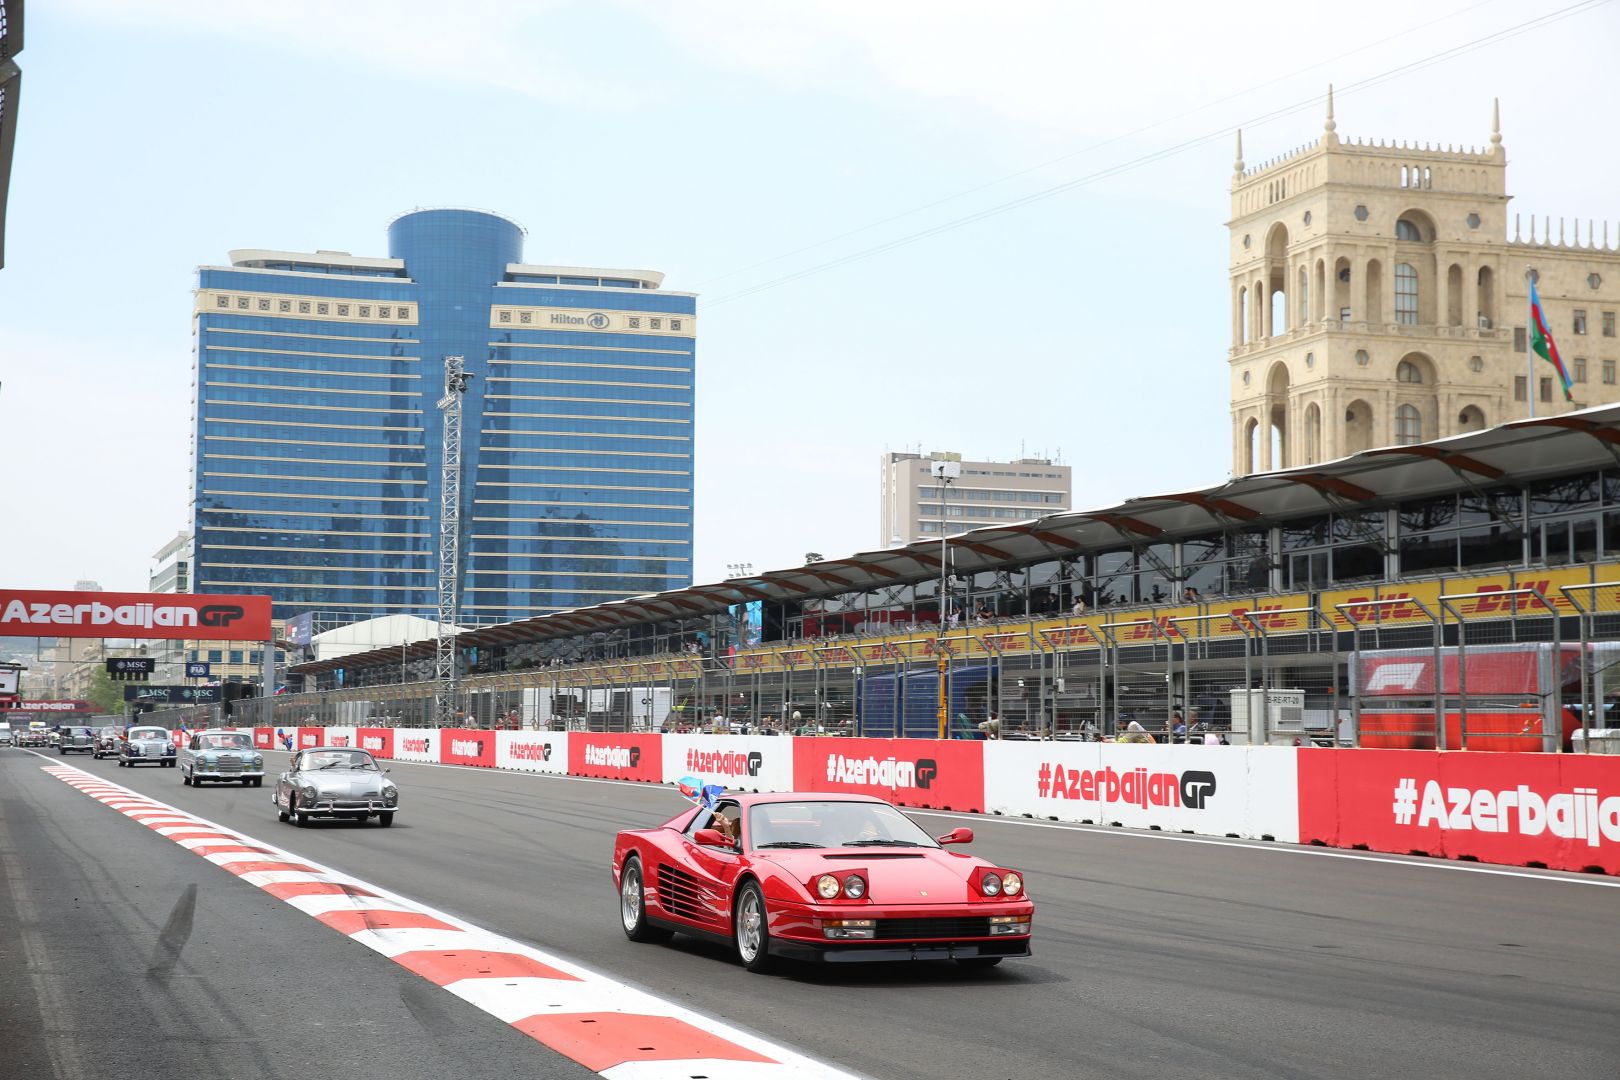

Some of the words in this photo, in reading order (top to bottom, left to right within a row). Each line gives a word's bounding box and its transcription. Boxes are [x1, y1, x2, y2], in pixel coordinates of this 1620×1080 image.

[550, 313, 584, 325] Hilton
[1475, 580, 1555, 612] DHL
[0, 599, 244, 628] AzerbaijanGP
[1347, 593, 1413, 621] DHL
[1133, 615, 1180, 638] DHL
[190, 665, 204, 673] FIA
[149, 689, 169, 697] MSC
[193, 689, 213, 697] MSC
